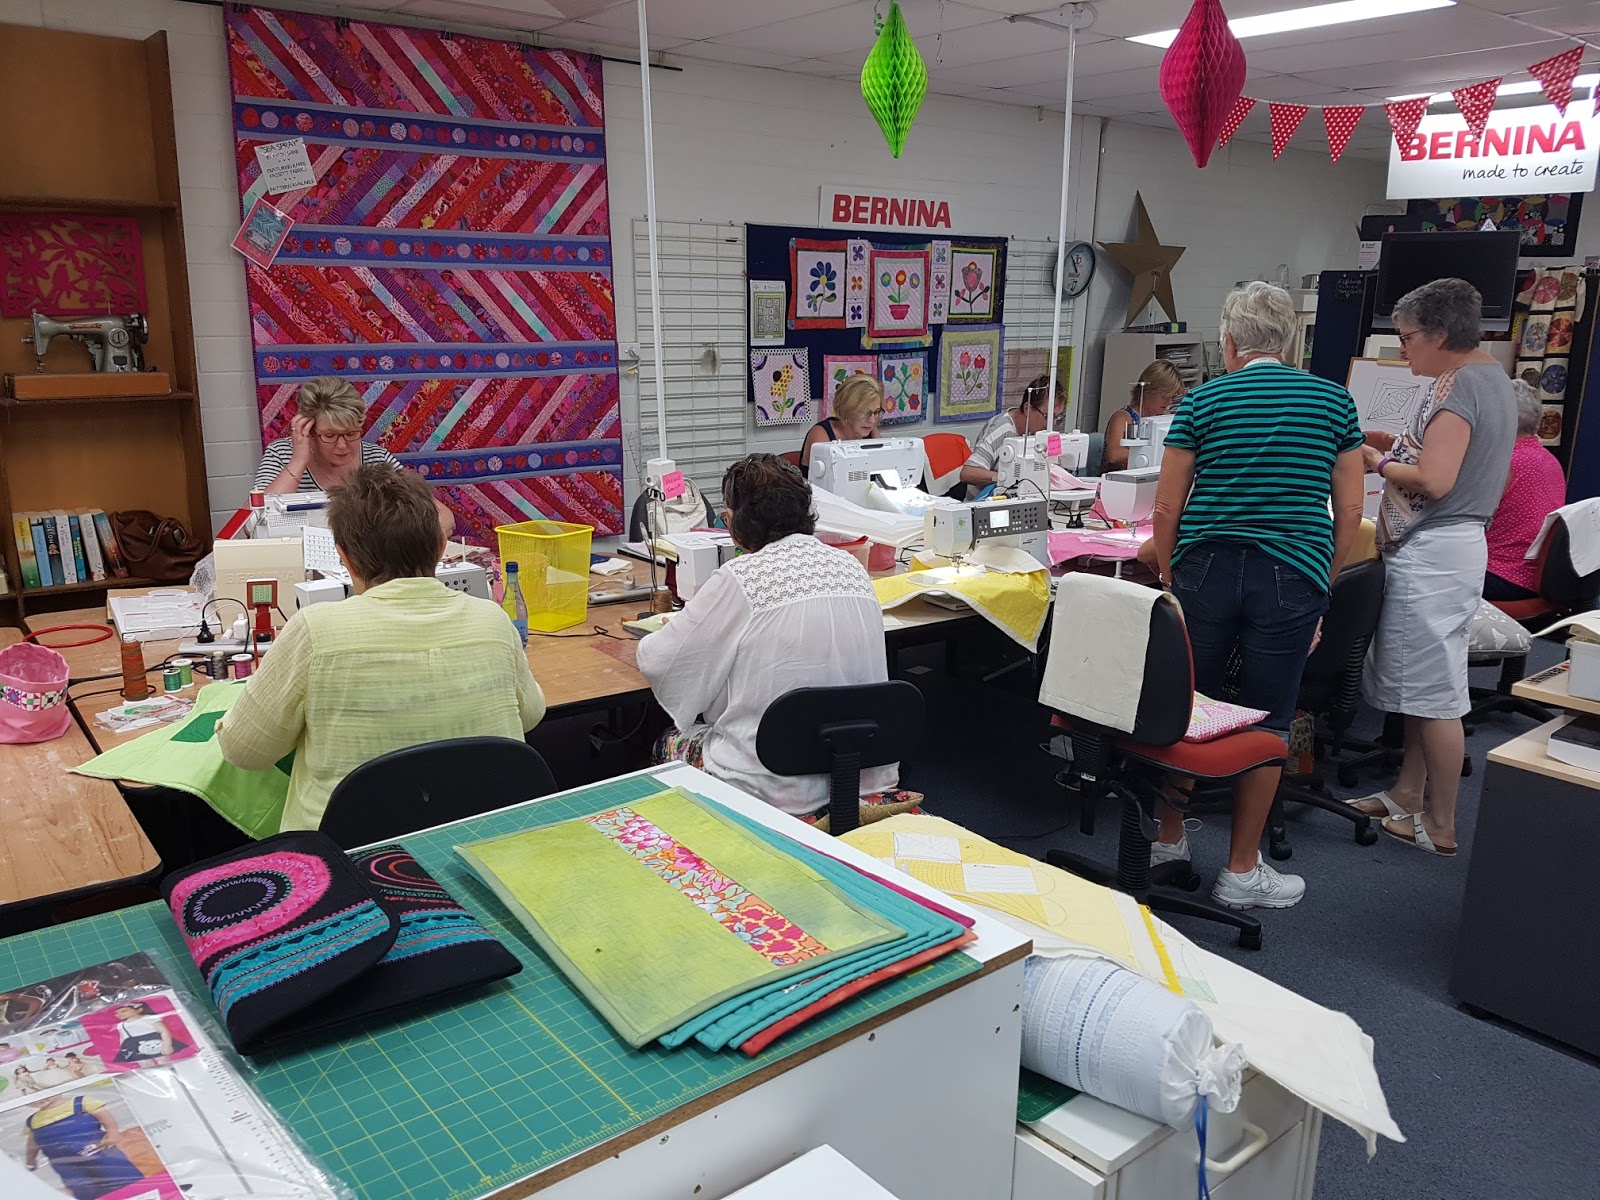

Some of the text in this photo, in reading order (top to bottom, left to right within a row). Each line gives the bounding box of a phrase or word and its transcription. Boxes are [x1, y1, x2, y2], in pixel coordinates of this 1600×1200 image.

[1401, 121, 1586, 162] BERNINA
[1462, 159, 1585, 180] made to create
[832, 194, 951, 228] BERNINA
